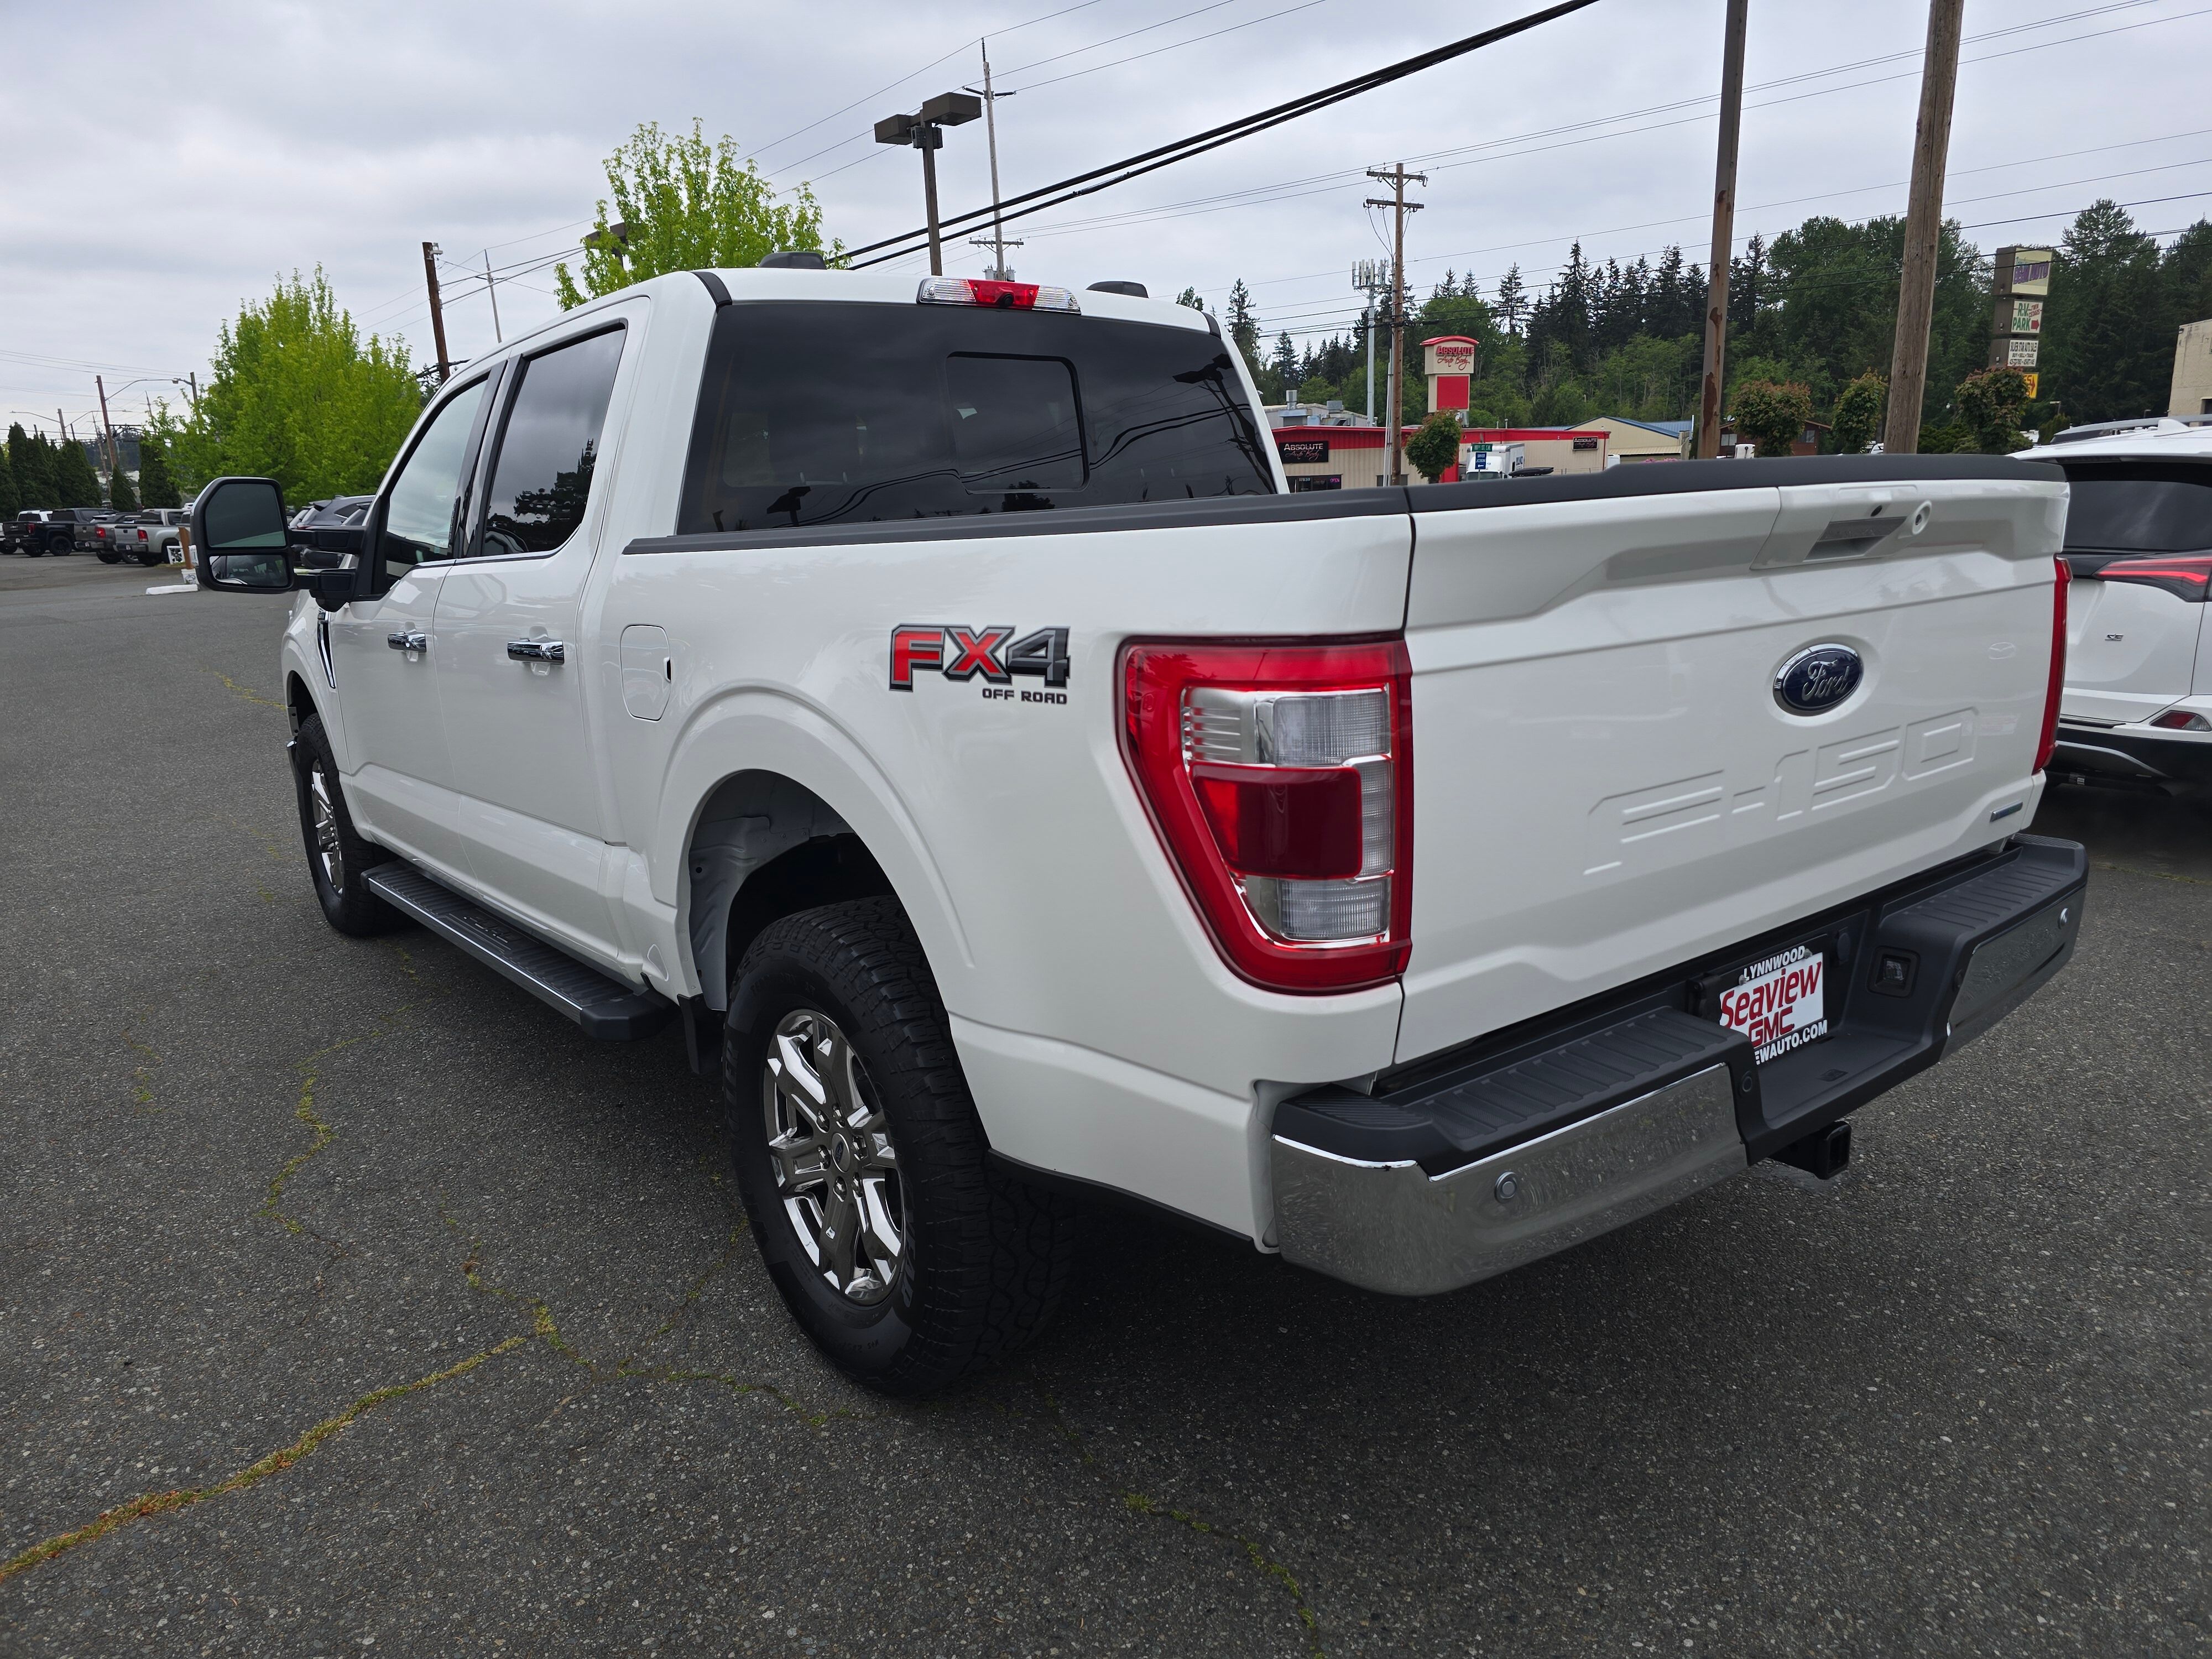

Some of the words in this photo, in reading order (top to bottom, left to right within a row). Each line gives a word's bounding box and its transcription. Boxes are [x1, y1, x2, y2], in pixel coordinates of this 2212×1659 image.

[2012, 317, 2031, 331] PARK
[1436, 346, 1474, 354] ABSOLUTE
[889, 623, 1071, 692] FX4
[982, 687, 1014, 700] OFF
[1021, 690, 1067, 705] ROAD
[1801, 659, 1850, 701] Ford
[1583, 706, 1980, 876] F-150
[1744, 945, 1806, 982] LYNNWOOD
[1721, 961, 1822, 1029] Seaview
[1748, 1005, 1795, 1048] GMC
